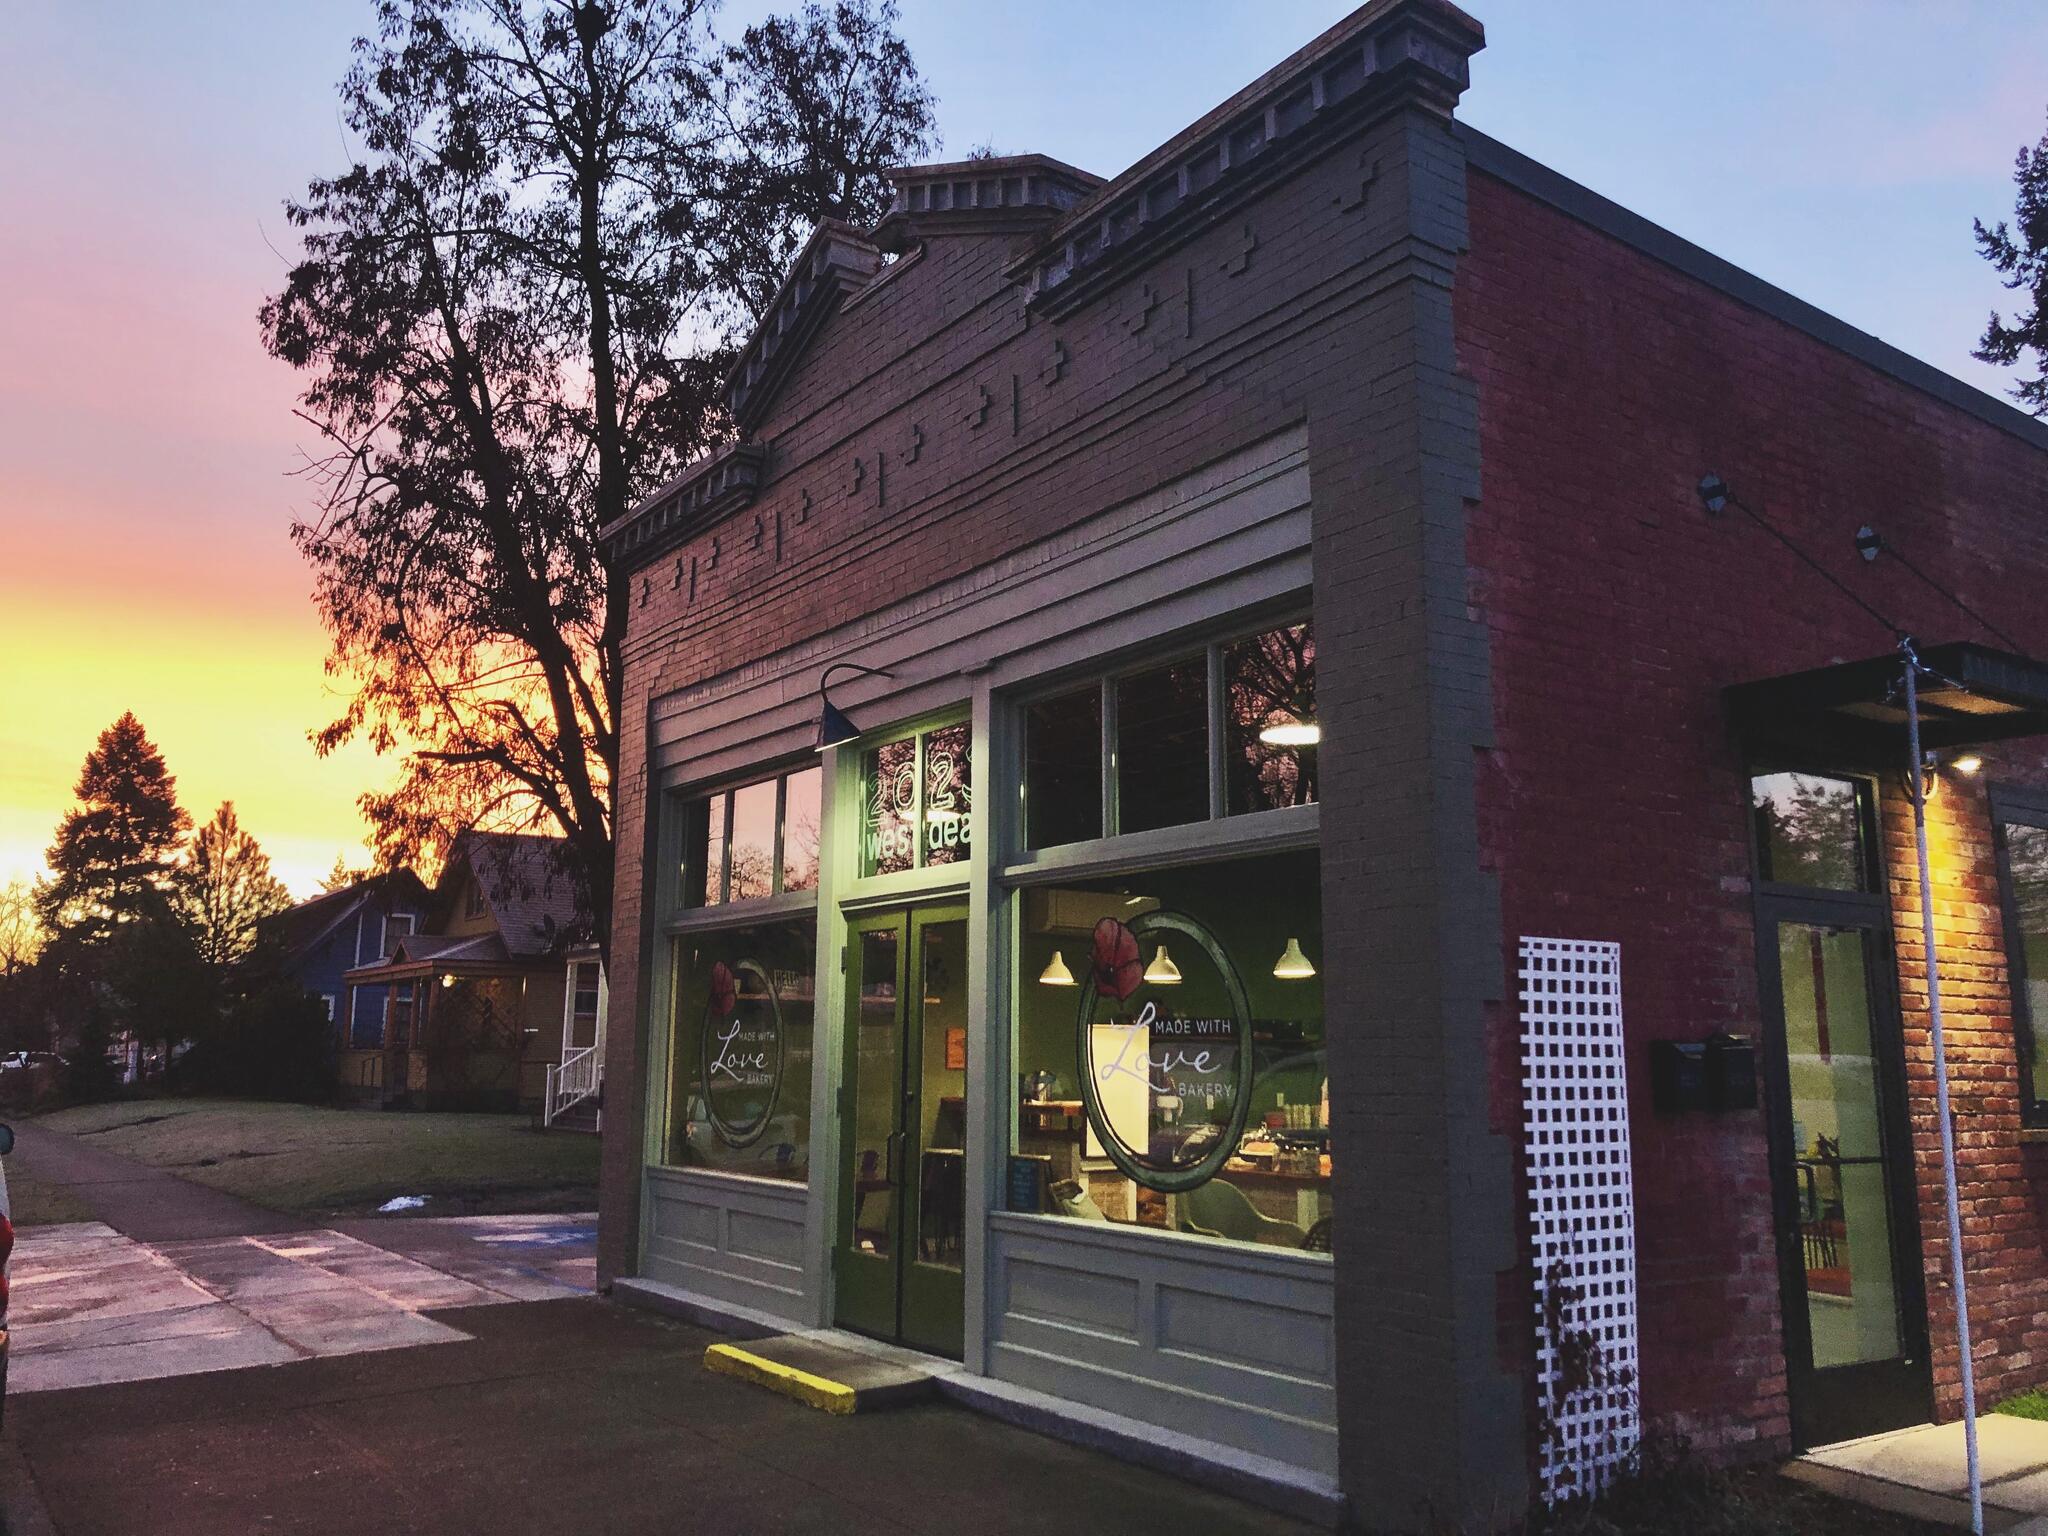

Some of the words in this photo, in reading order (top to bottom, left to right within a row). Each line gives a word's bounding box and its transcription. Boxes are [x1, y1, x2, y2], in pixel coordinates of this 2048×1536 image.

[866, 823, 914, 861] wes
[1155, 1020, 1191, 1034] MADE
[1195, 1019, 1231, 1034] WITH
[738, 1031, 756, 1041] MADE
[711, 1019, 768, 1082] Love
[1101, 1001, 1221, 1093] Love
[746, 1073, 775, 1085] BAKERY
[1178, 1082, 1232, 1097] BAKERY
